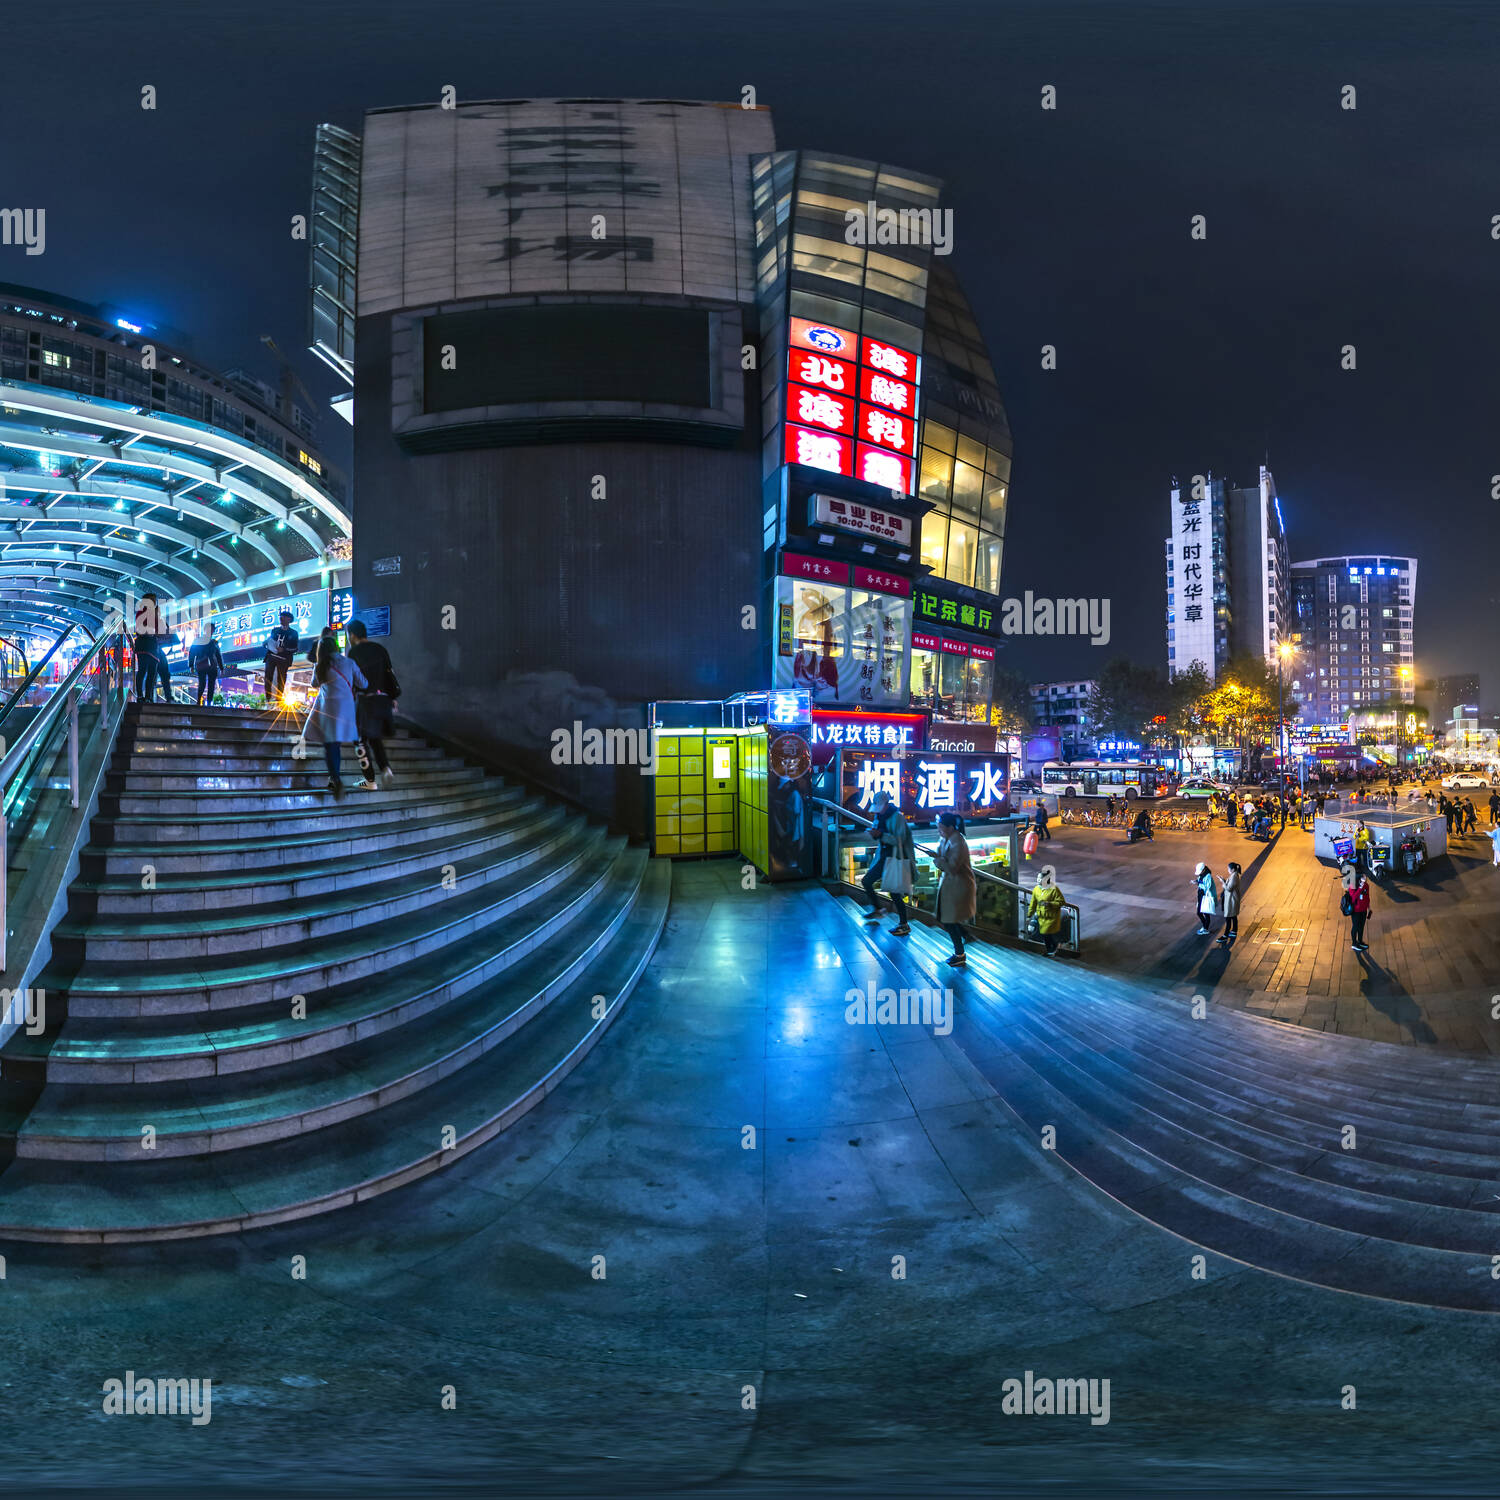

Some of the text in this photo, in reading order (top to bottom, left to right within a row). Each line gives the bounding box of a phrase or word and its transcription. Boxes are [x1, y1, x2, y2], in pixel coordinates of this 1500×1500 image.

[1183, 543, 1203, 623] 时代华章
[912, 591, 993, 630] 记茶餐厅
[774, 694, 799, 722] 存
[857, 760, 1006, 810] 烟酒水
